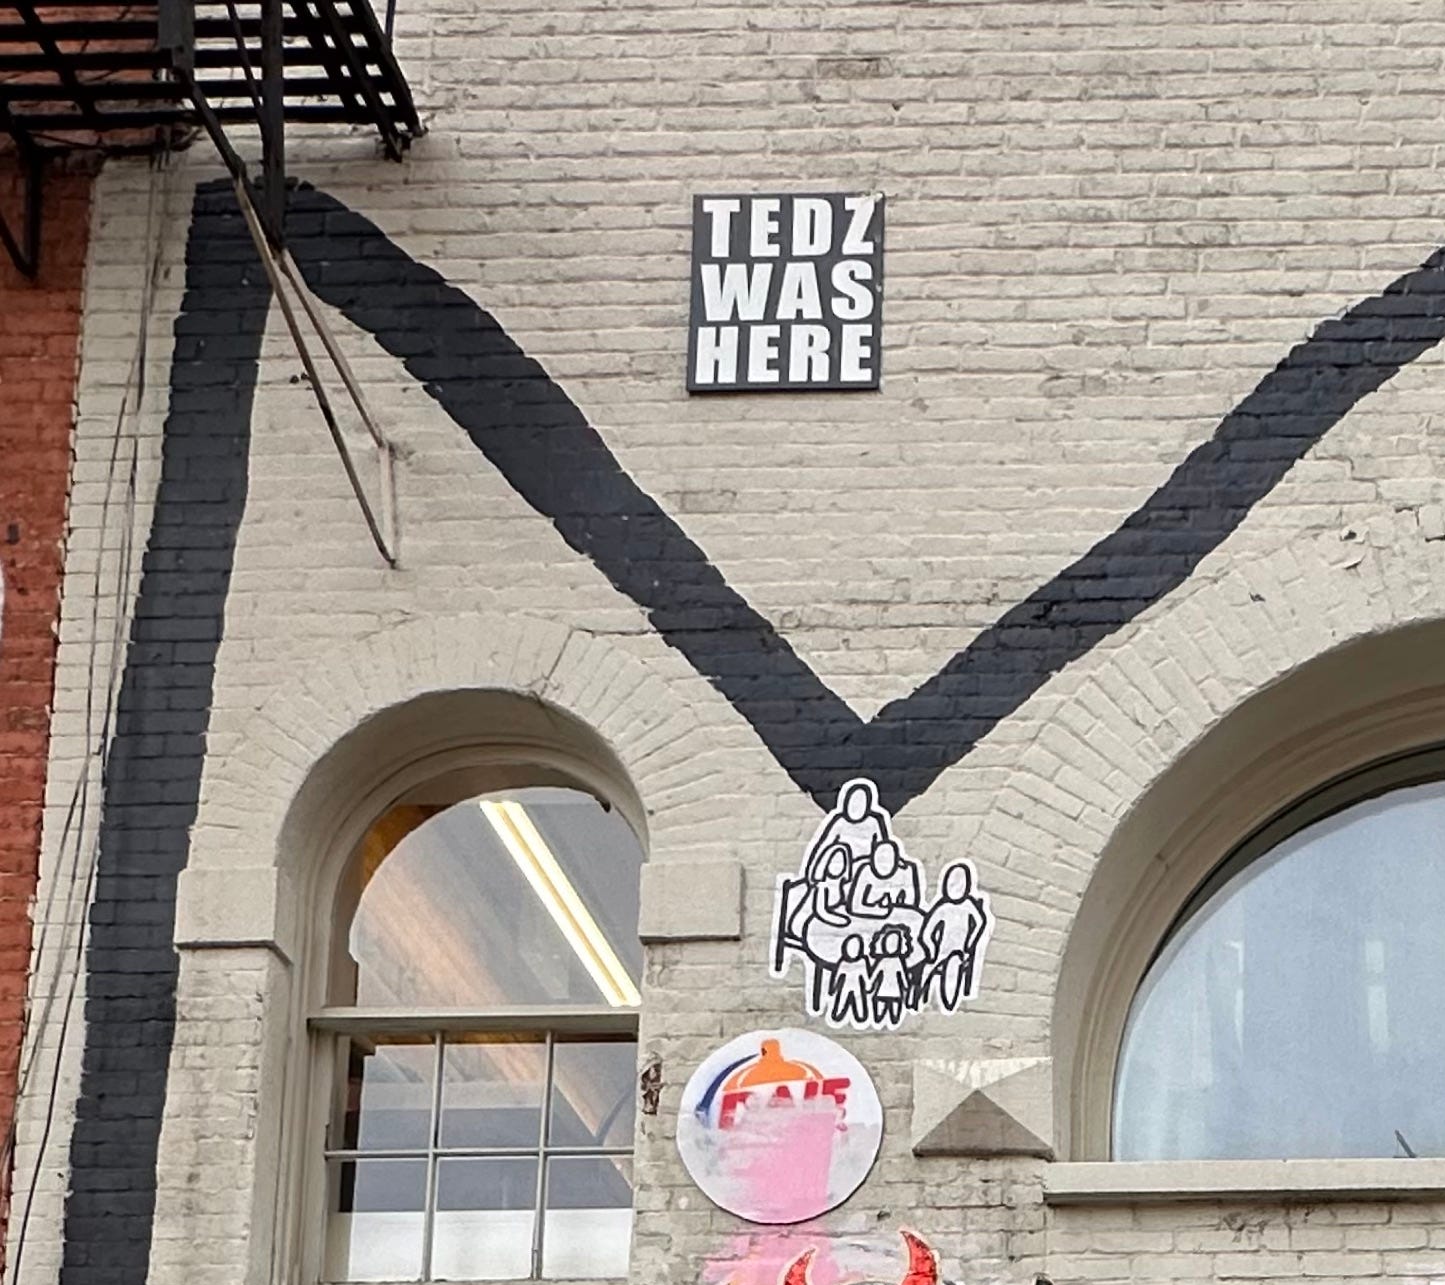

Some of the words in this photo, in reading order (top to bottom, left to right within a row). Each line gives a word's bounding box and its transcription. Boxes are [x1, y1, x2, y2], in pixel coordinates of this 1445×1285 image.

[702, 198, 876, 257] TEDZ
[700, 260, 875, 321] WAS
[695, 324, 874, 384] HERE
